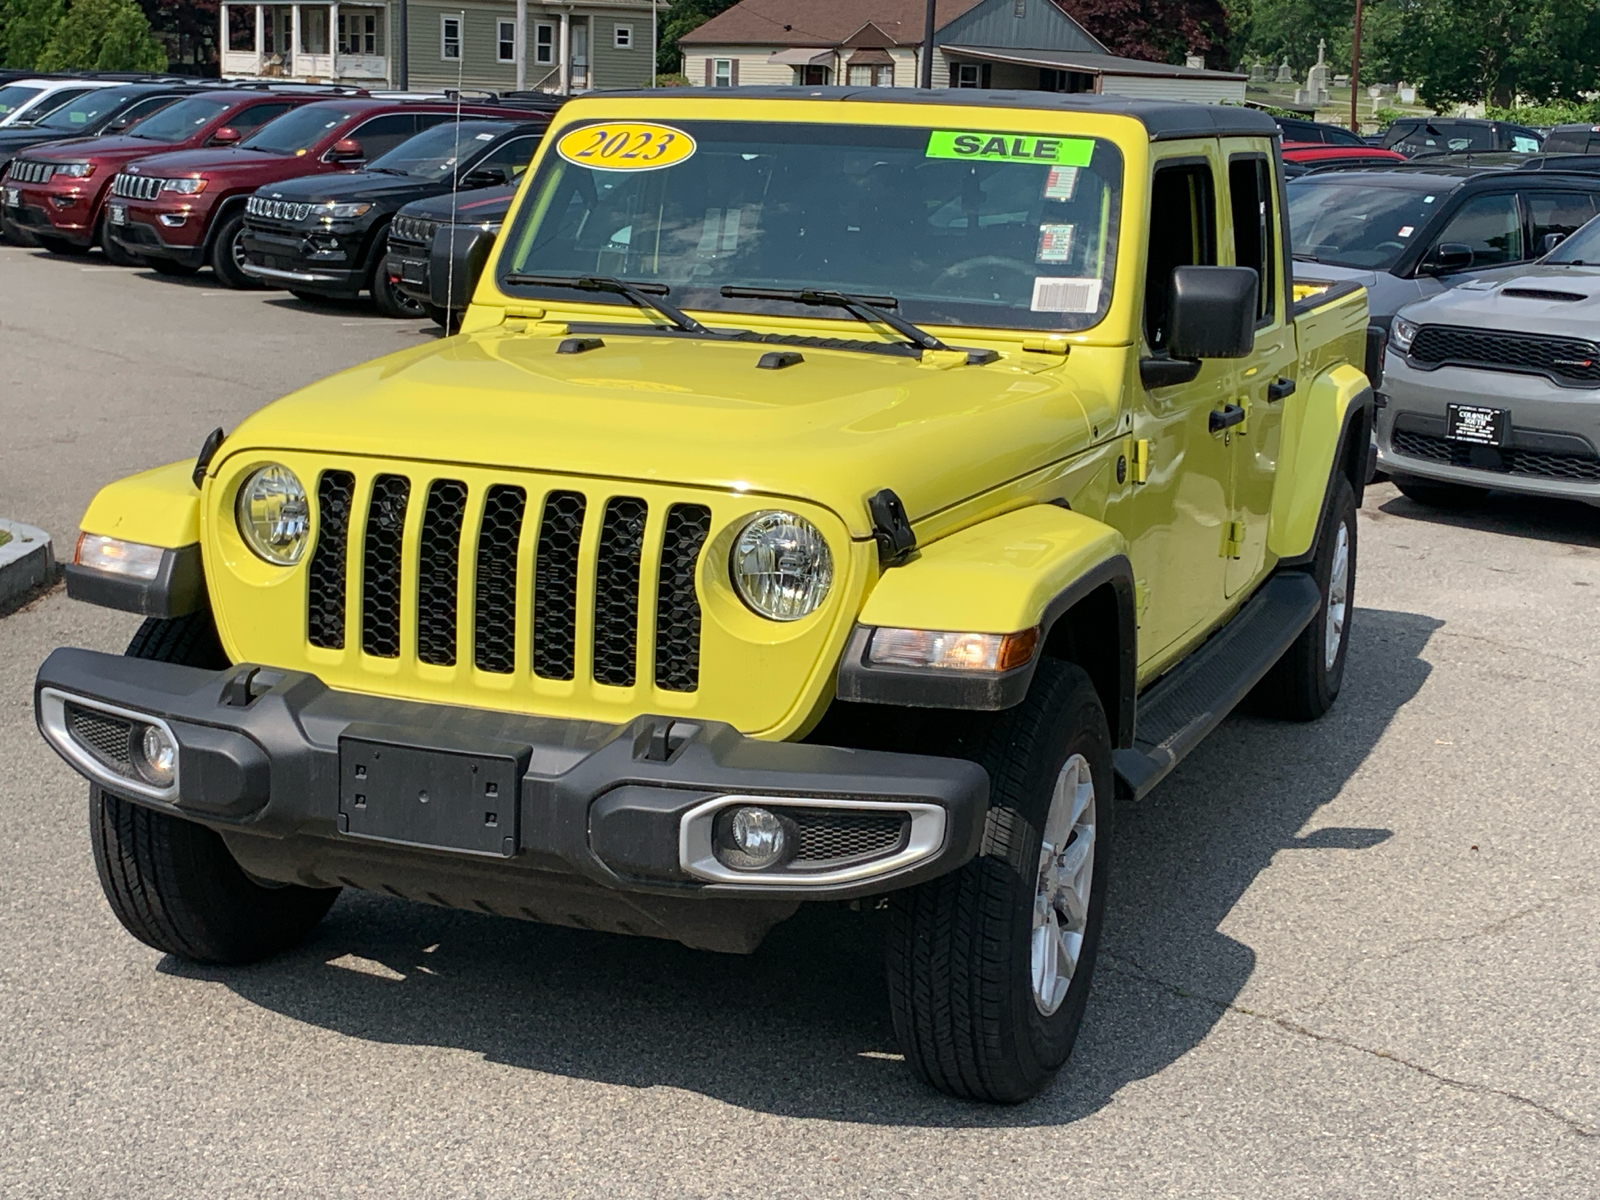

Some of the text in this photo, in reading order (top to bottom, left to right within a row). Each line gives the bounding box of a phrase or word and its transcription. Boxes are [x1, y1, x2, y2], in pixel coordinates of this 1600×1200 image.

[575, 131, 675, 160] 2023
[953, 135, 1062, 161] SALE
[1459, 411, 1493, 421] COLONIAL
